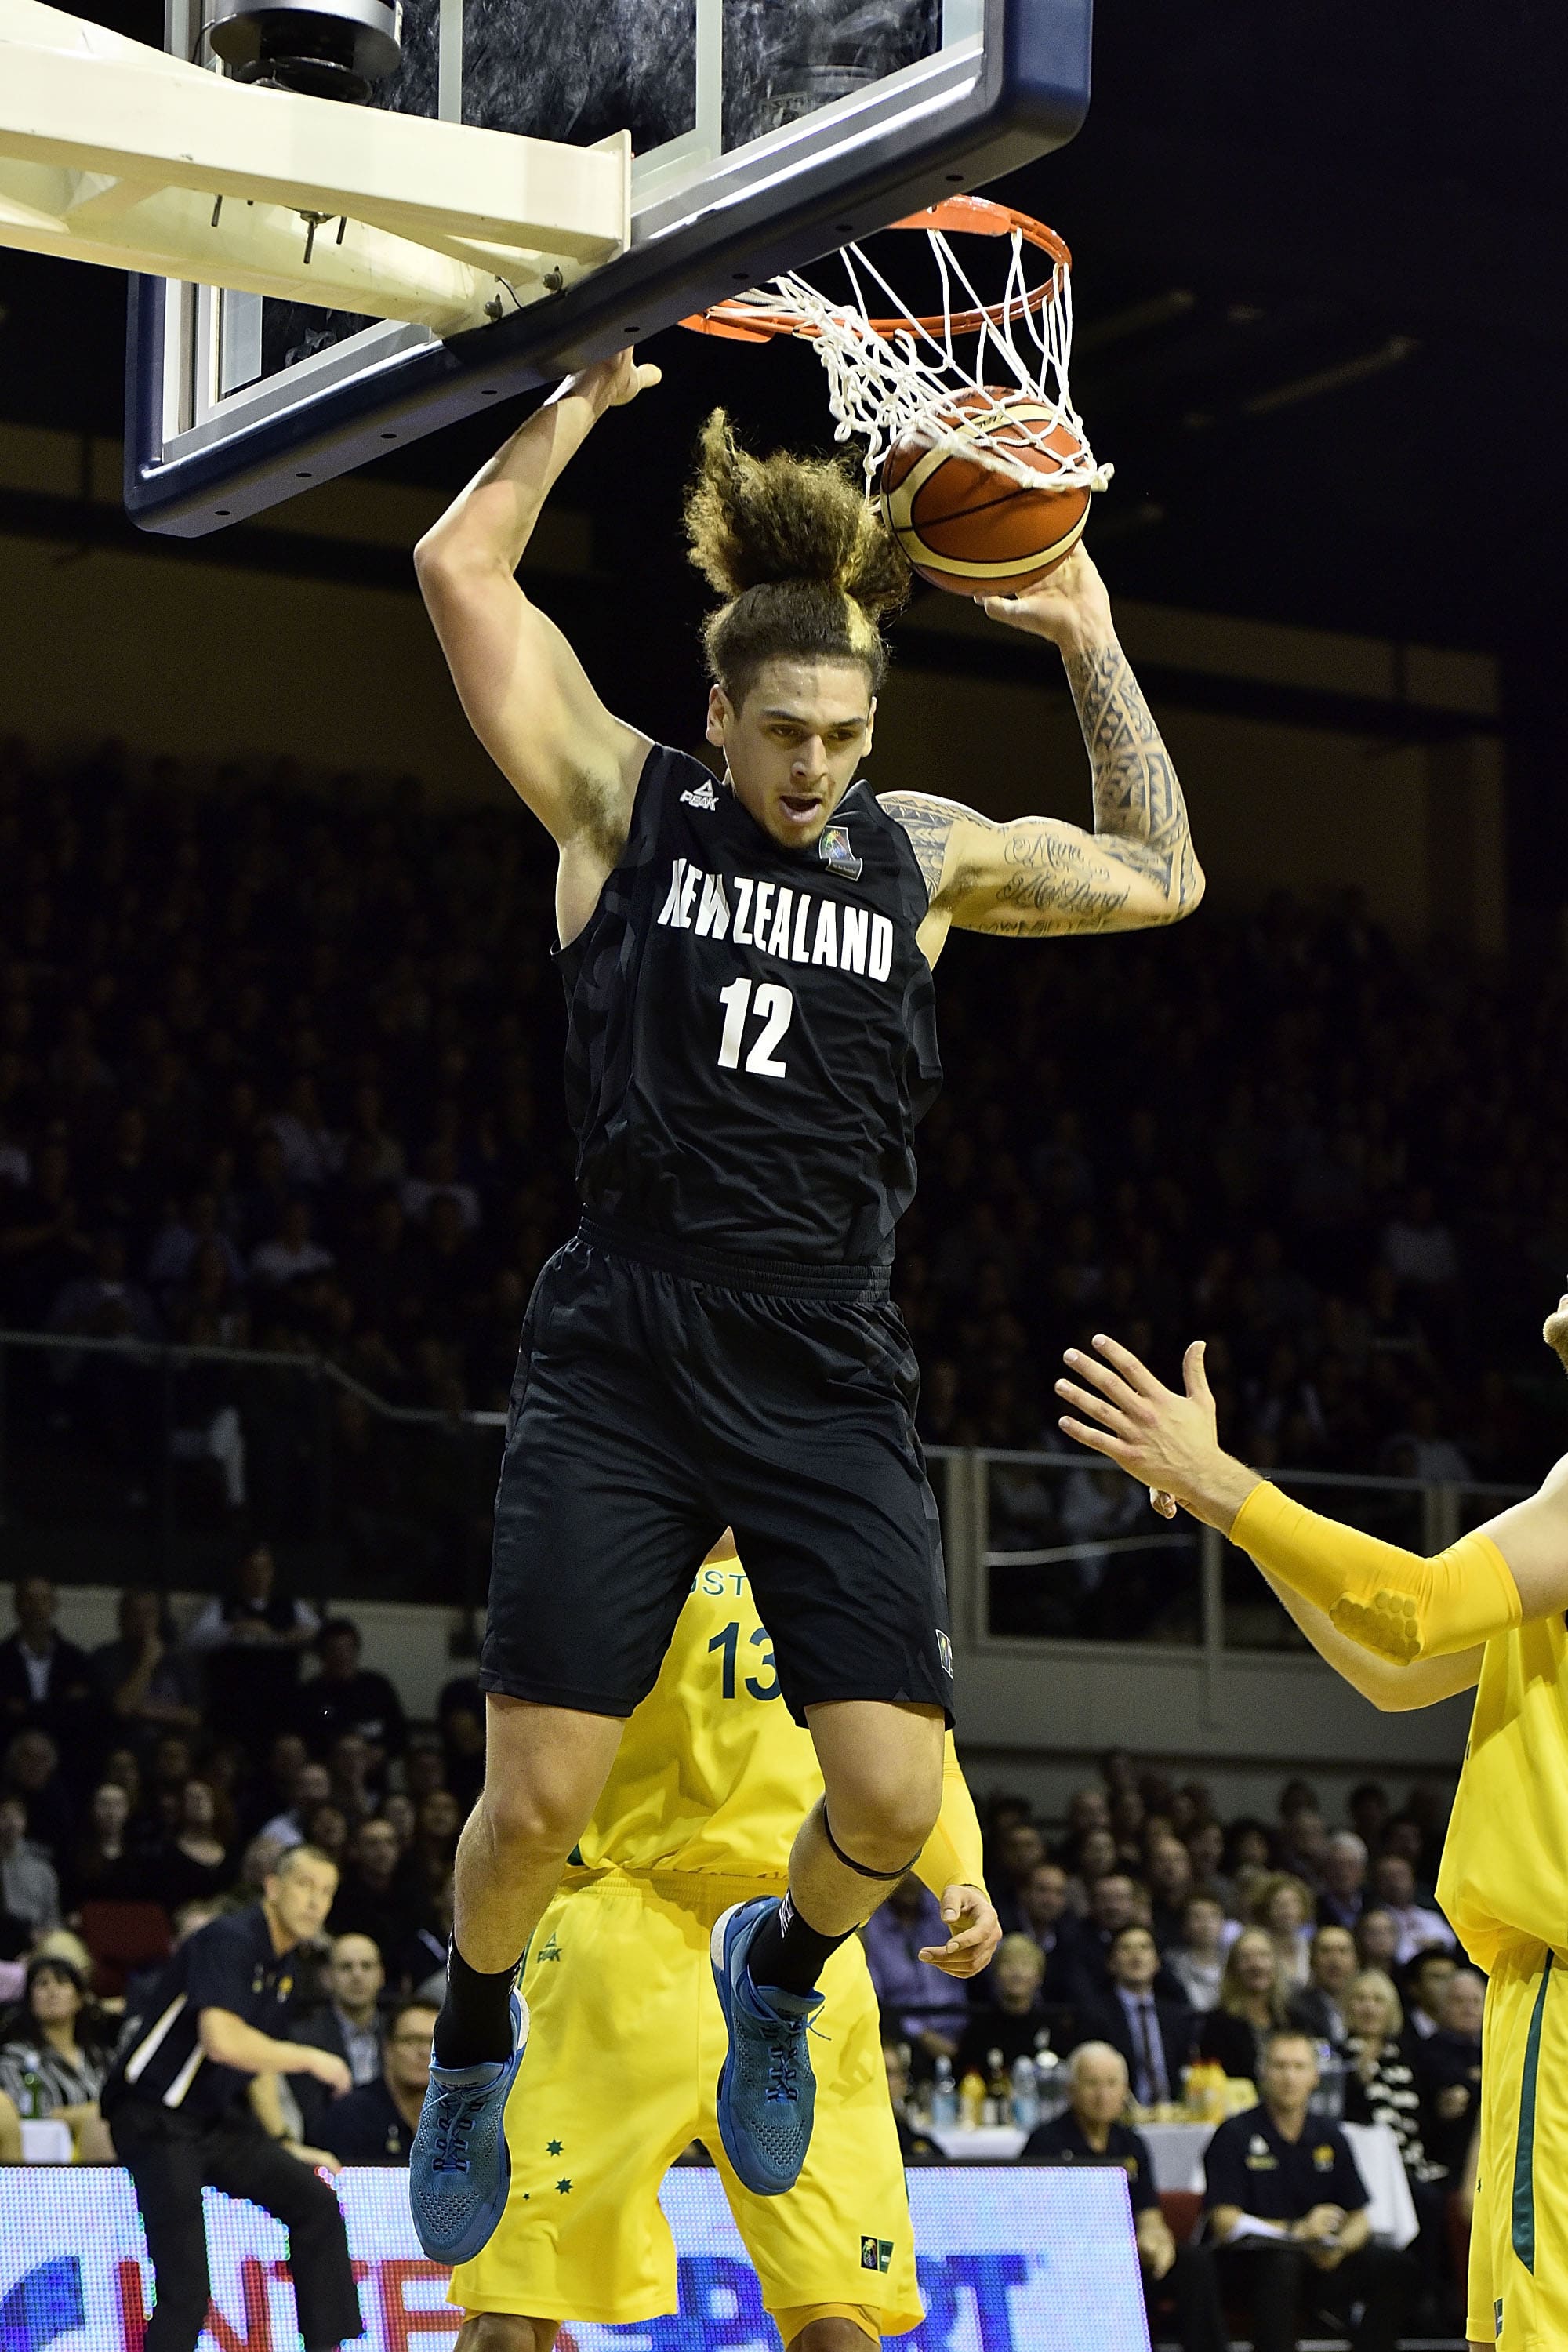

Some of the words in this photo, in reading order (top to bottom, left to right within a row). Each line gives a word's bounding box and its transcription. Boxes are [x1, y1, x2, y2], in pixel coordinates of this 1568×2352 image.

[679, 789, 720, 811] PEAK
[658, 858, 731, 940] NEW
[732, 877, 894, 982] ZEALAND
[717, 976, 793, 1079] 12
[708, 1622, 782, 1701] 13
